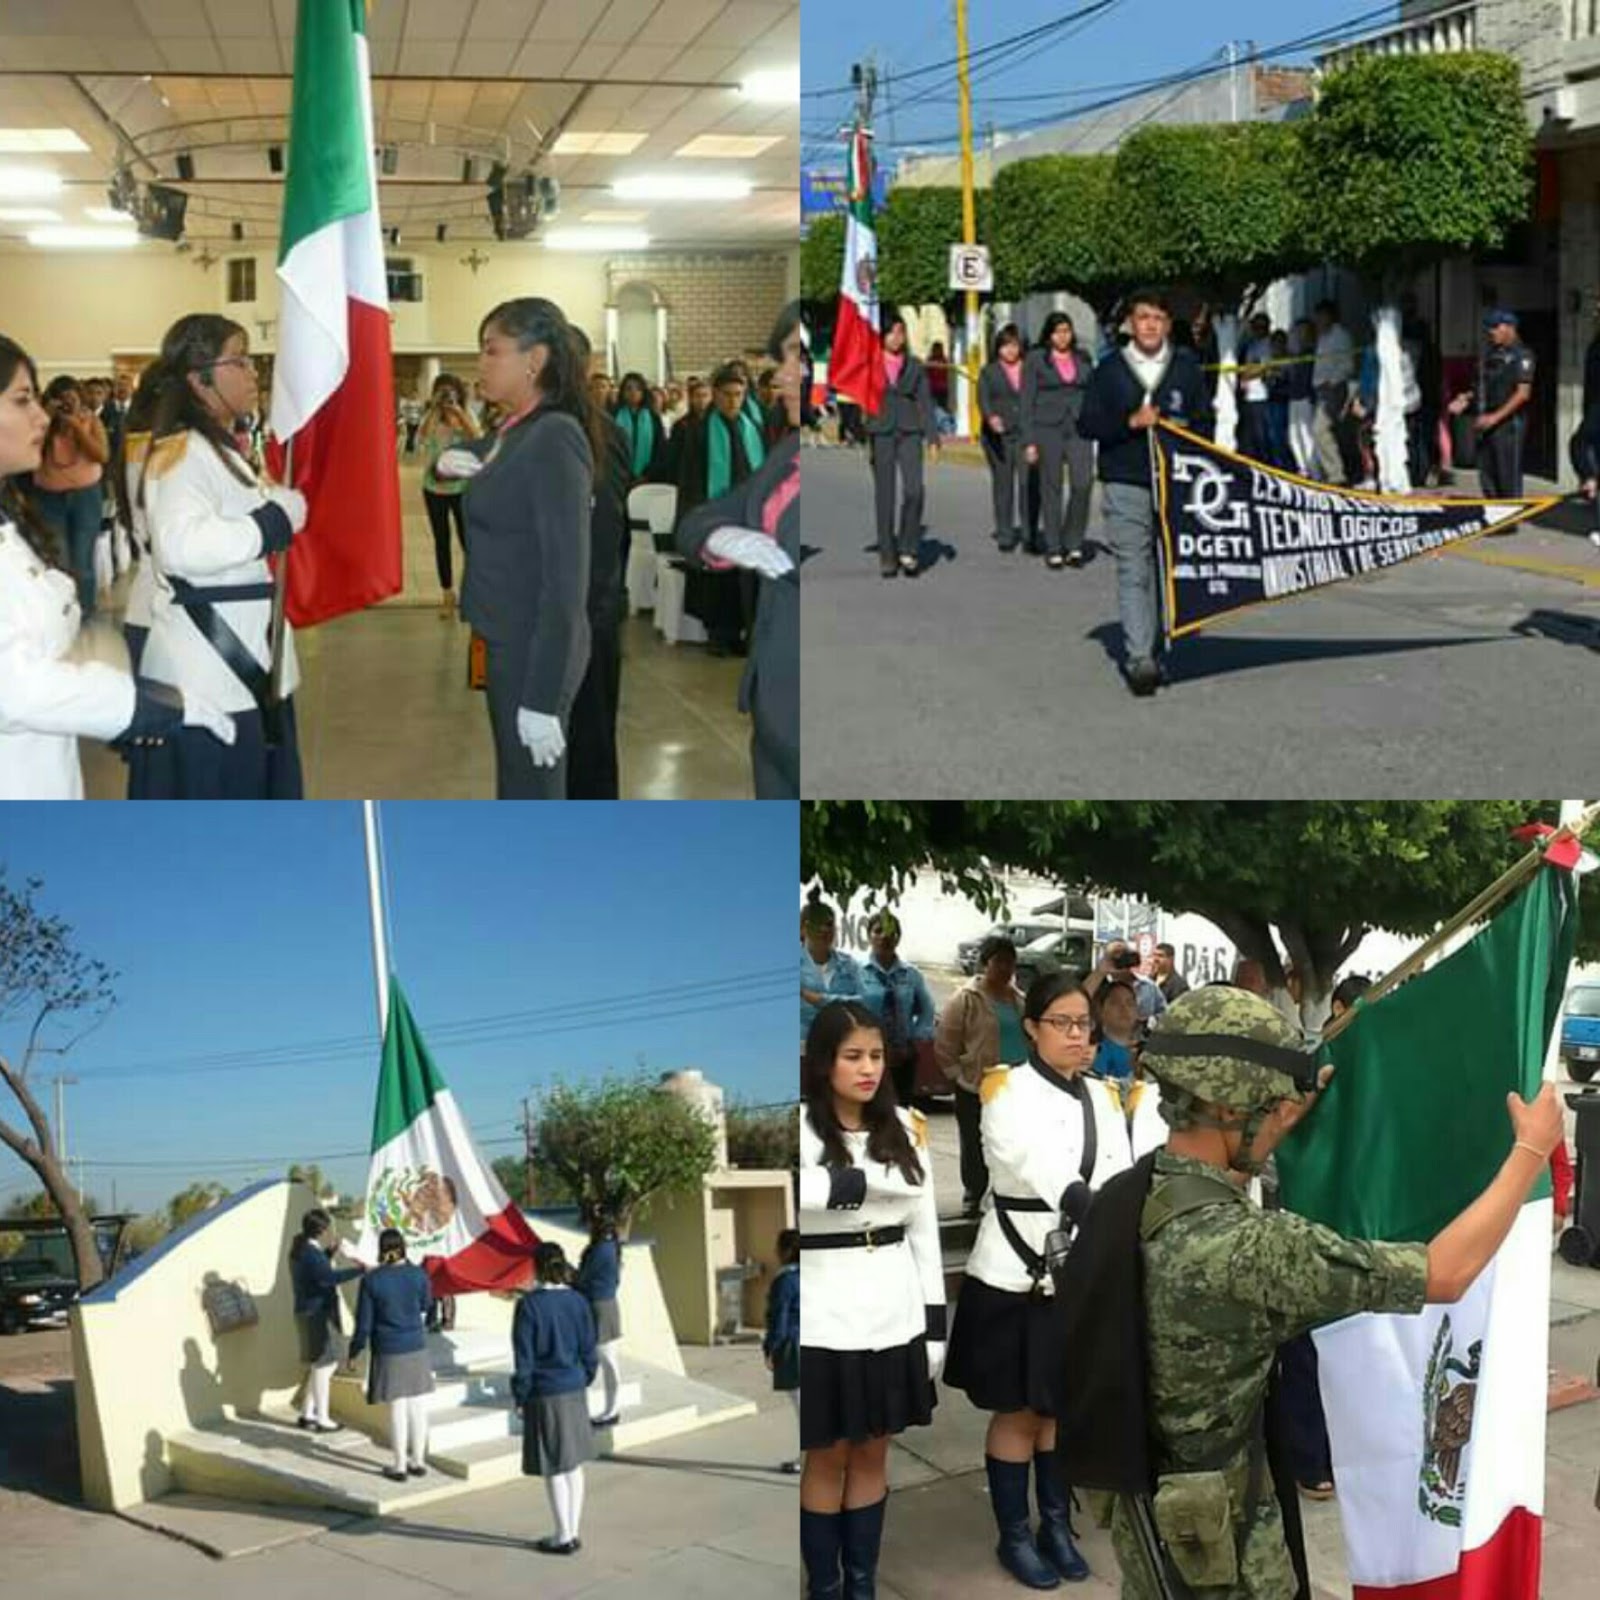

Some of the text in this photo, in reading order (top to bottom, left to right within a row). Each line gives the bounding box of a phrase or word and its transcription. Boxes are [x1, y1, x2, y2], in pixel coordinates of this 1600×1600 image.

[962, 257, 978, 278] E
[1254, 506, 1418, 551] TECNOLOGICOS
[1178, 533, 1254, 558] DGETI
